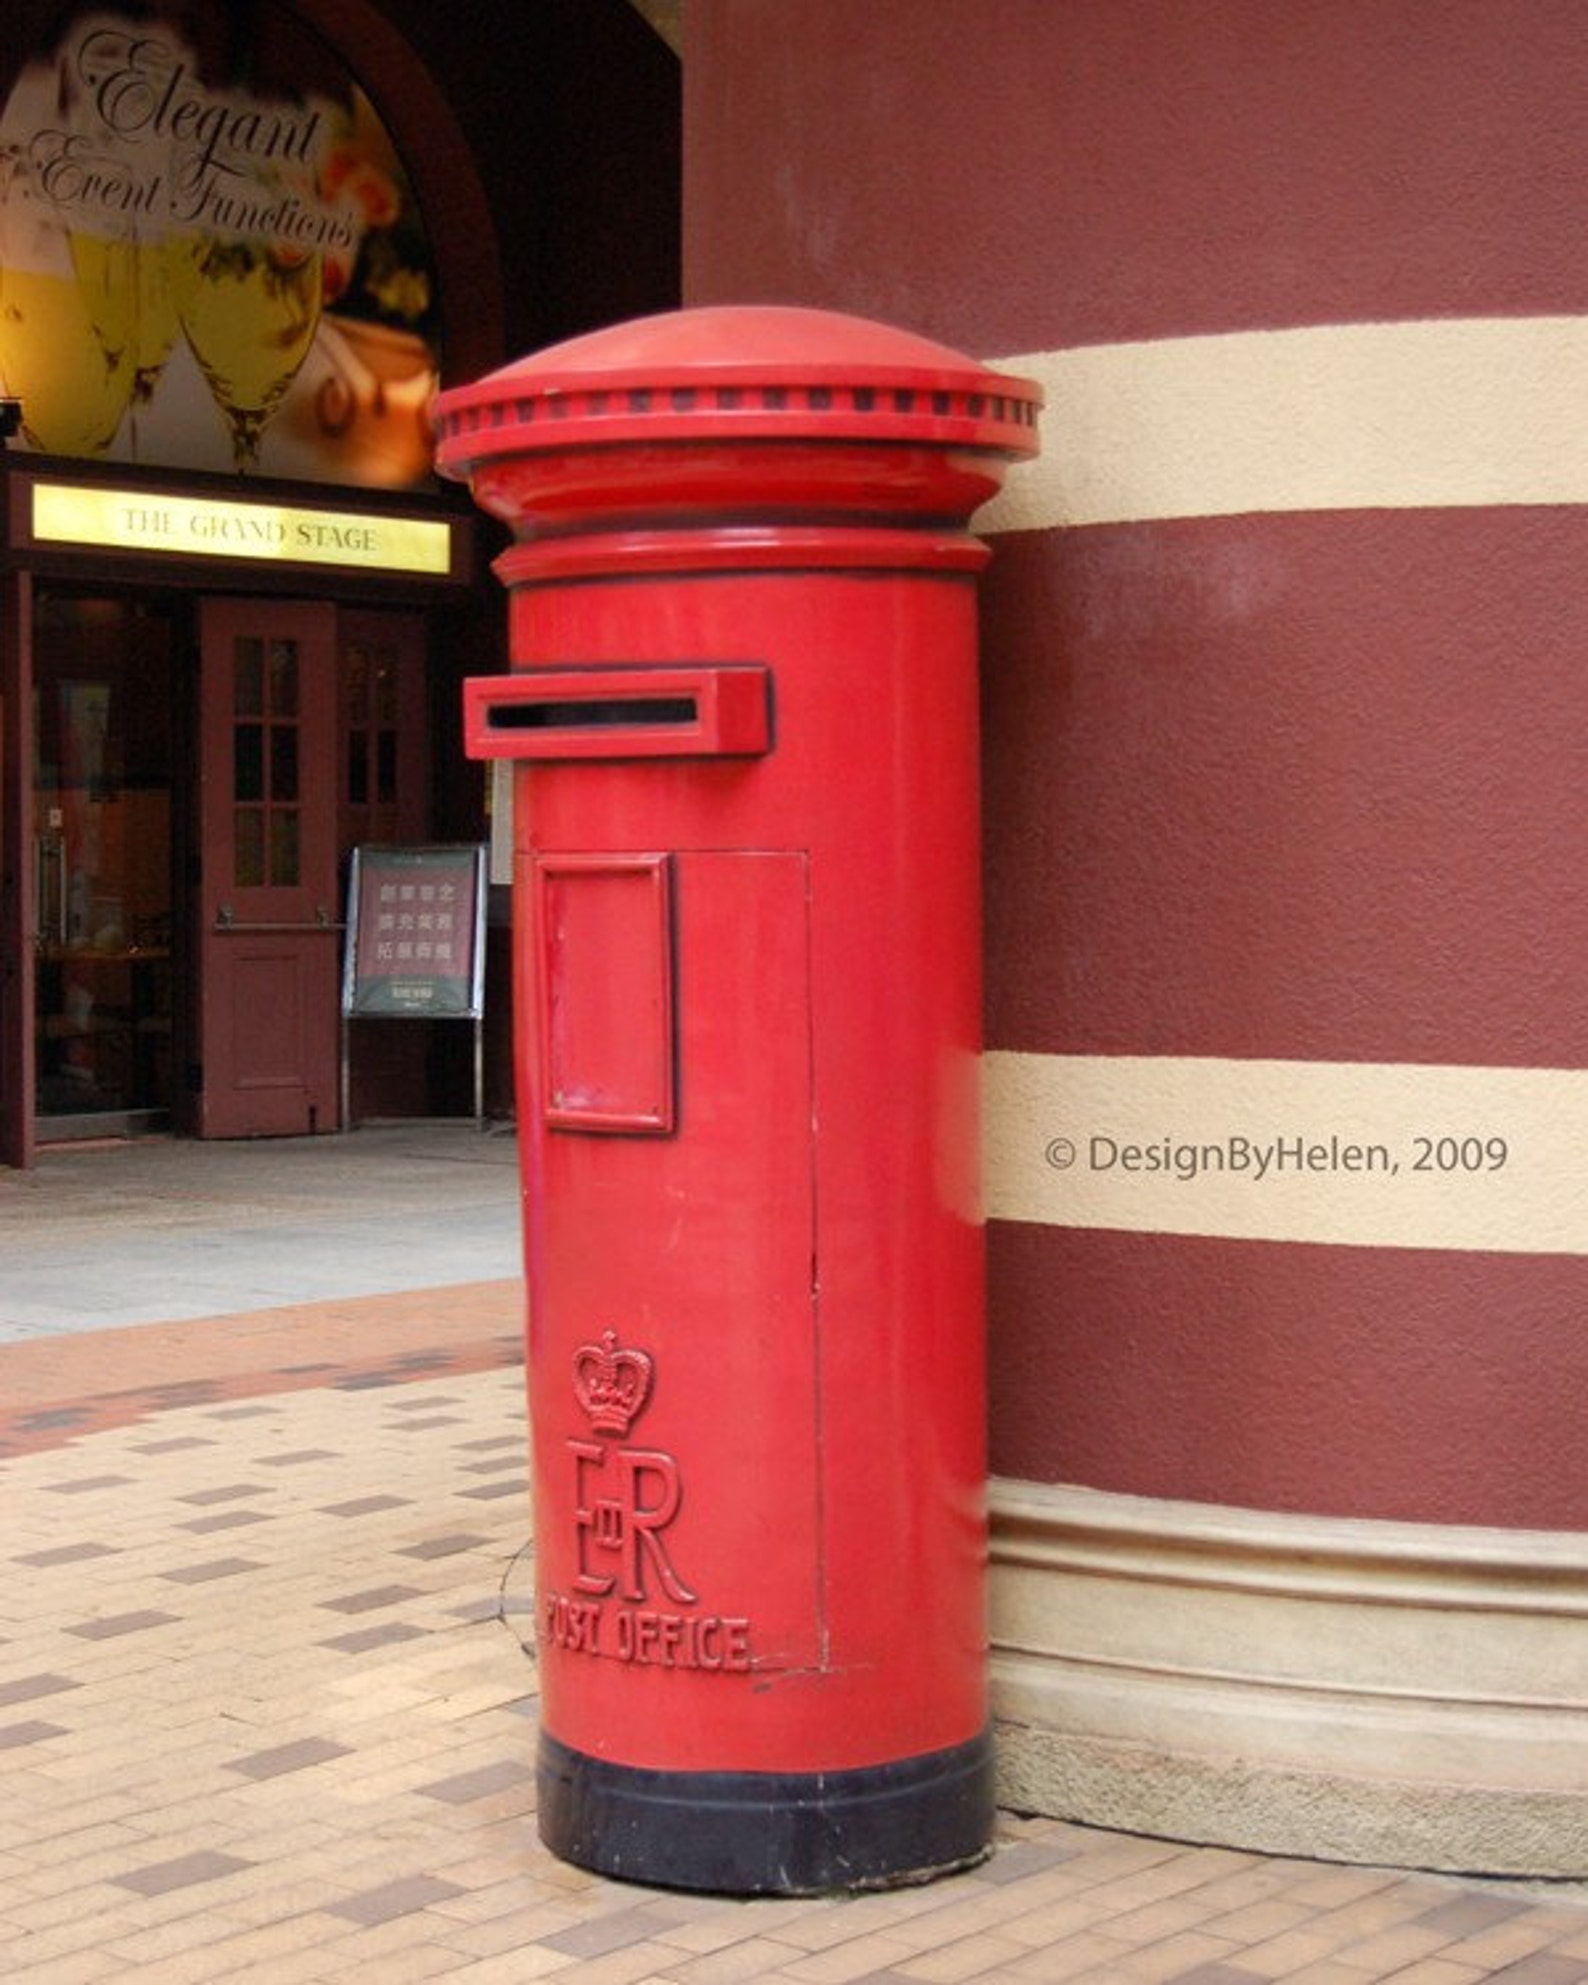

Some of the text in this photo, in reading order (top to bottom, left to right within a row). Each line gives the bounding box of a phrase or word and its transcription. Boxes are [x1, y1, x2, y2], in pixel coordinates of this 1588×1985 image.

[78, 30, 322, 188] Elegant
[30, 129, 162, 211] Event
[122, 507, 382, 552] THE GRAND STAGE
[617, 1610, 752, 1673] OFFICE
